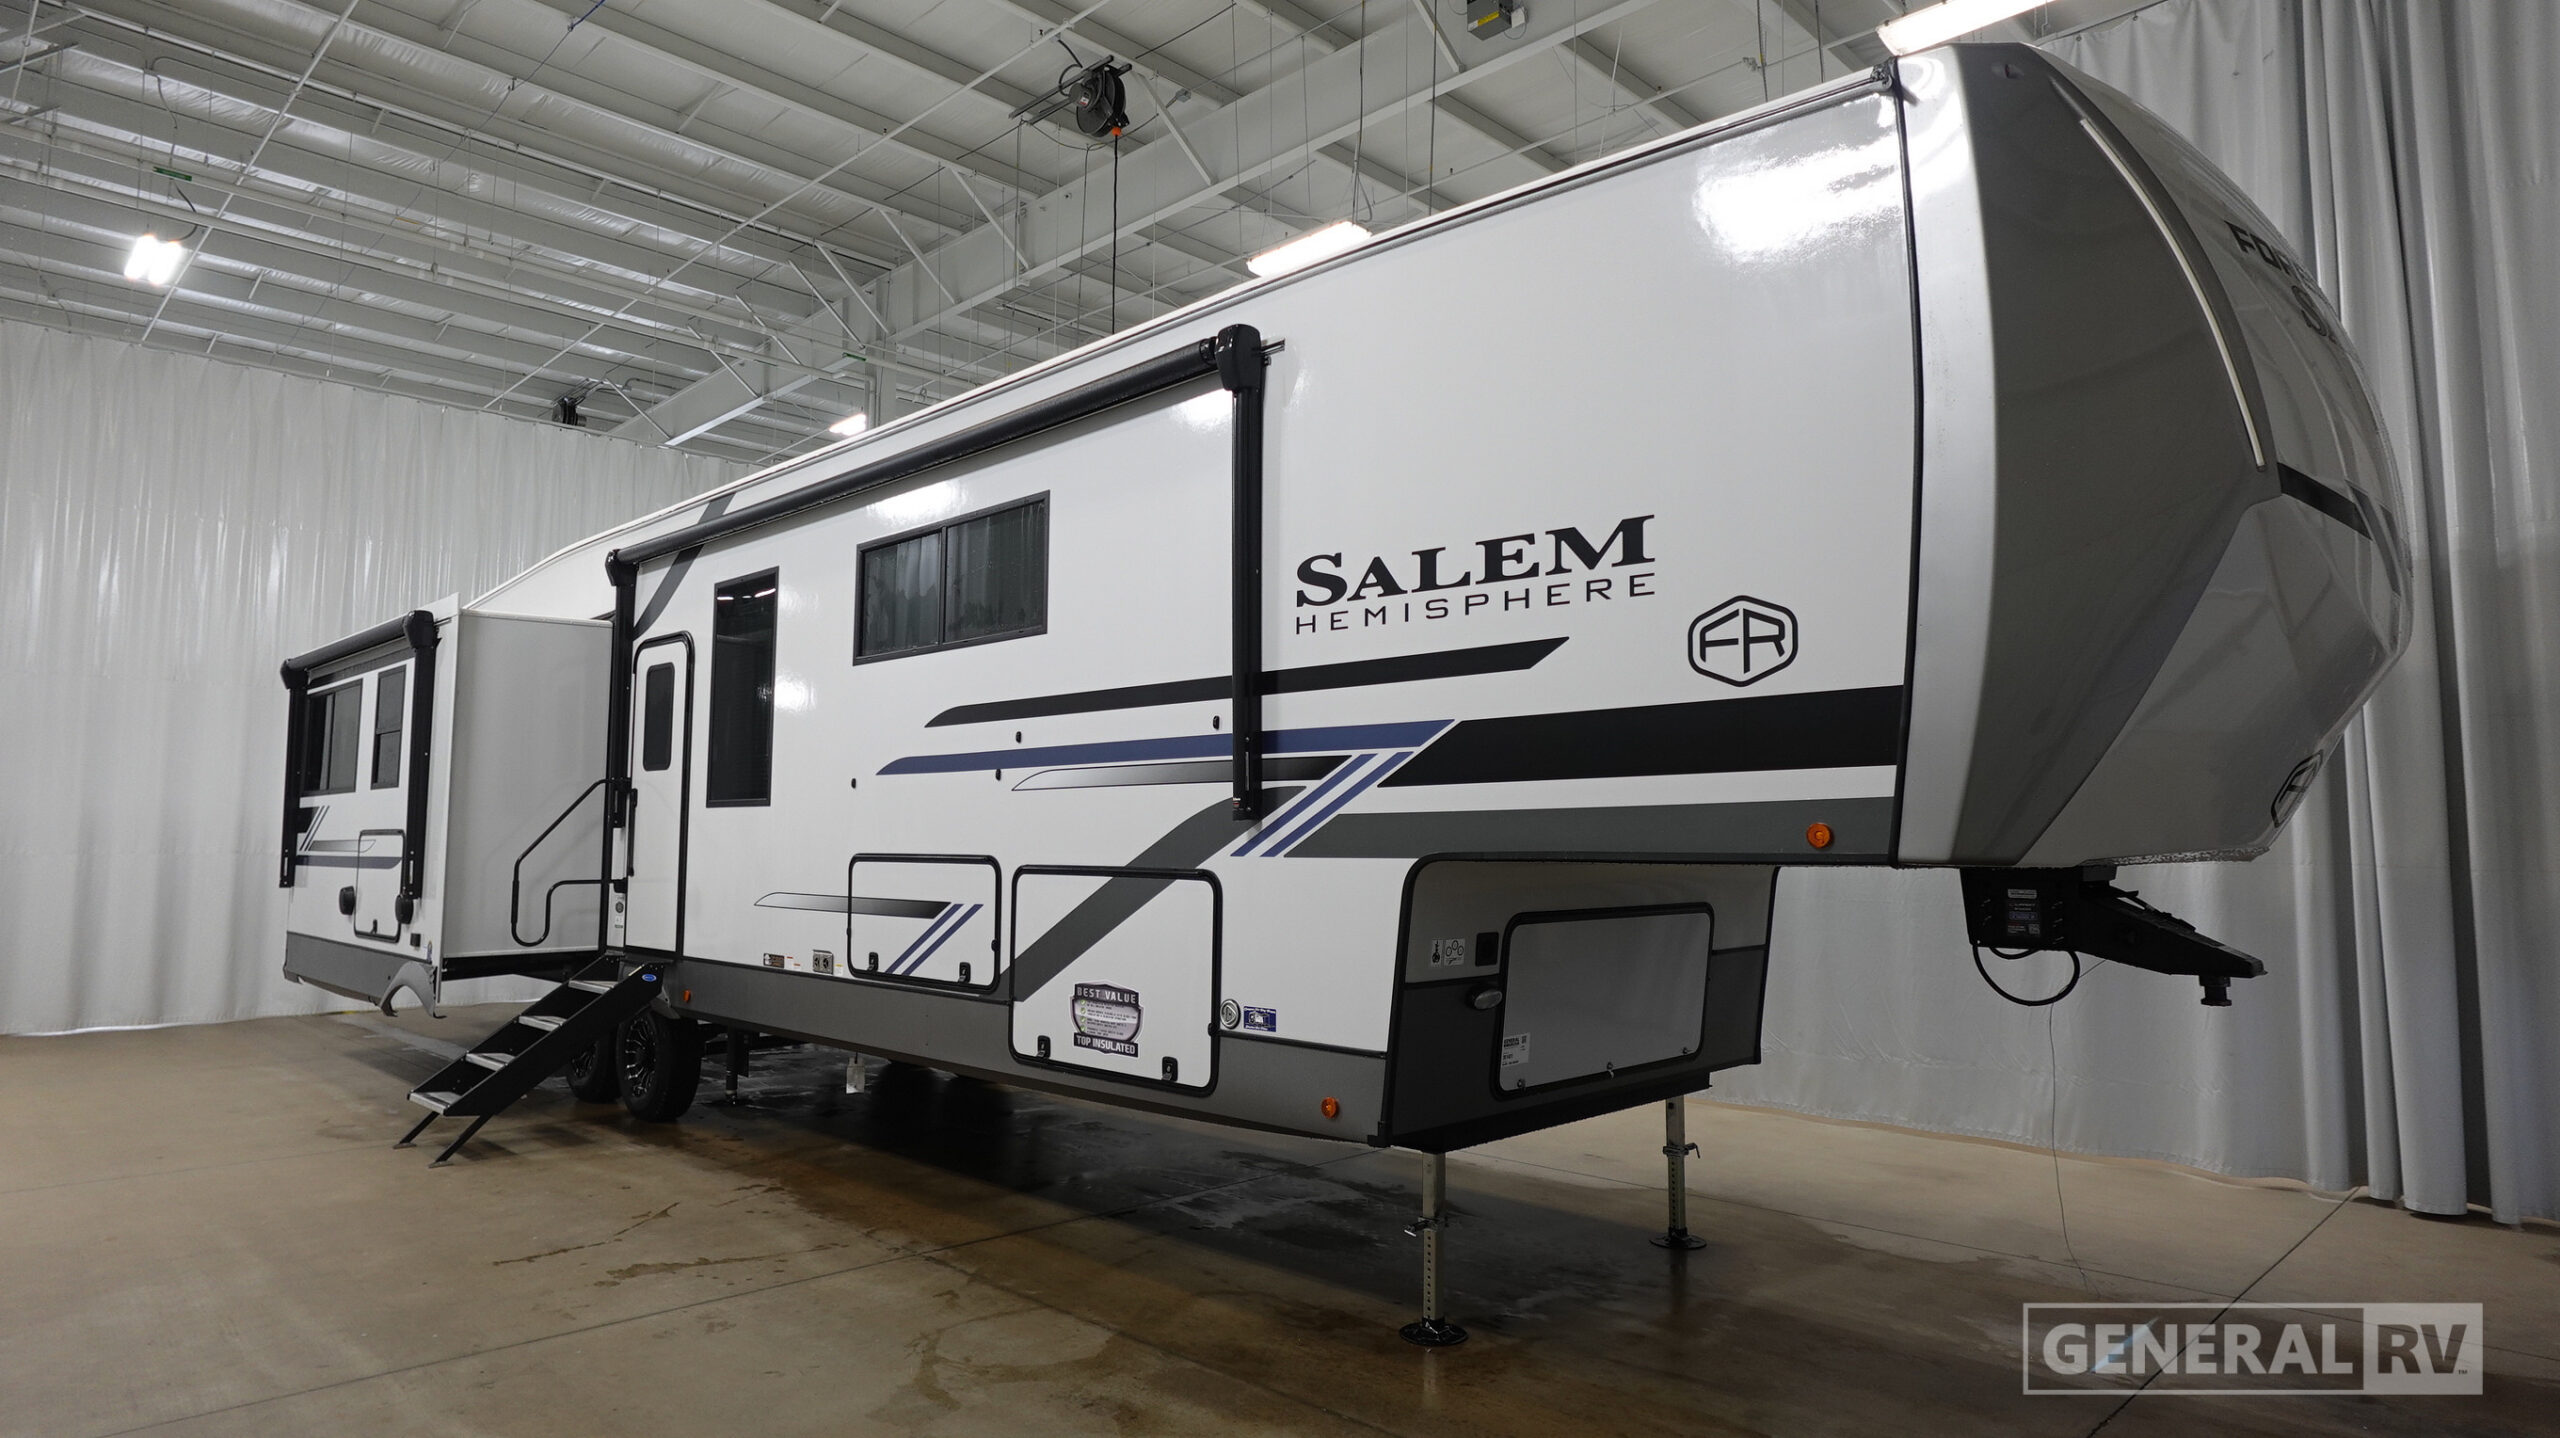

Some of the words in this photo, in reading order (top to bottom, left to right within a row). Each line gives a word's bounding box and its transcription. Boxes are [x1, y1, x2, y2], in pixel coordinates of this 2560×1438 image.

[1296, 514, 1656, 608] SALEM
[1296, 572, 1656, 635] HEMISPHERE
[1699, 607, 1786, 675] FR
[1077, 986, 1100, 999] BEST
[1105, 990, 1136, 1004] VALUE
[1076, 1035, 1091, 1046] TOP
[1092, 1037, 1136, 1055] INSULATED
